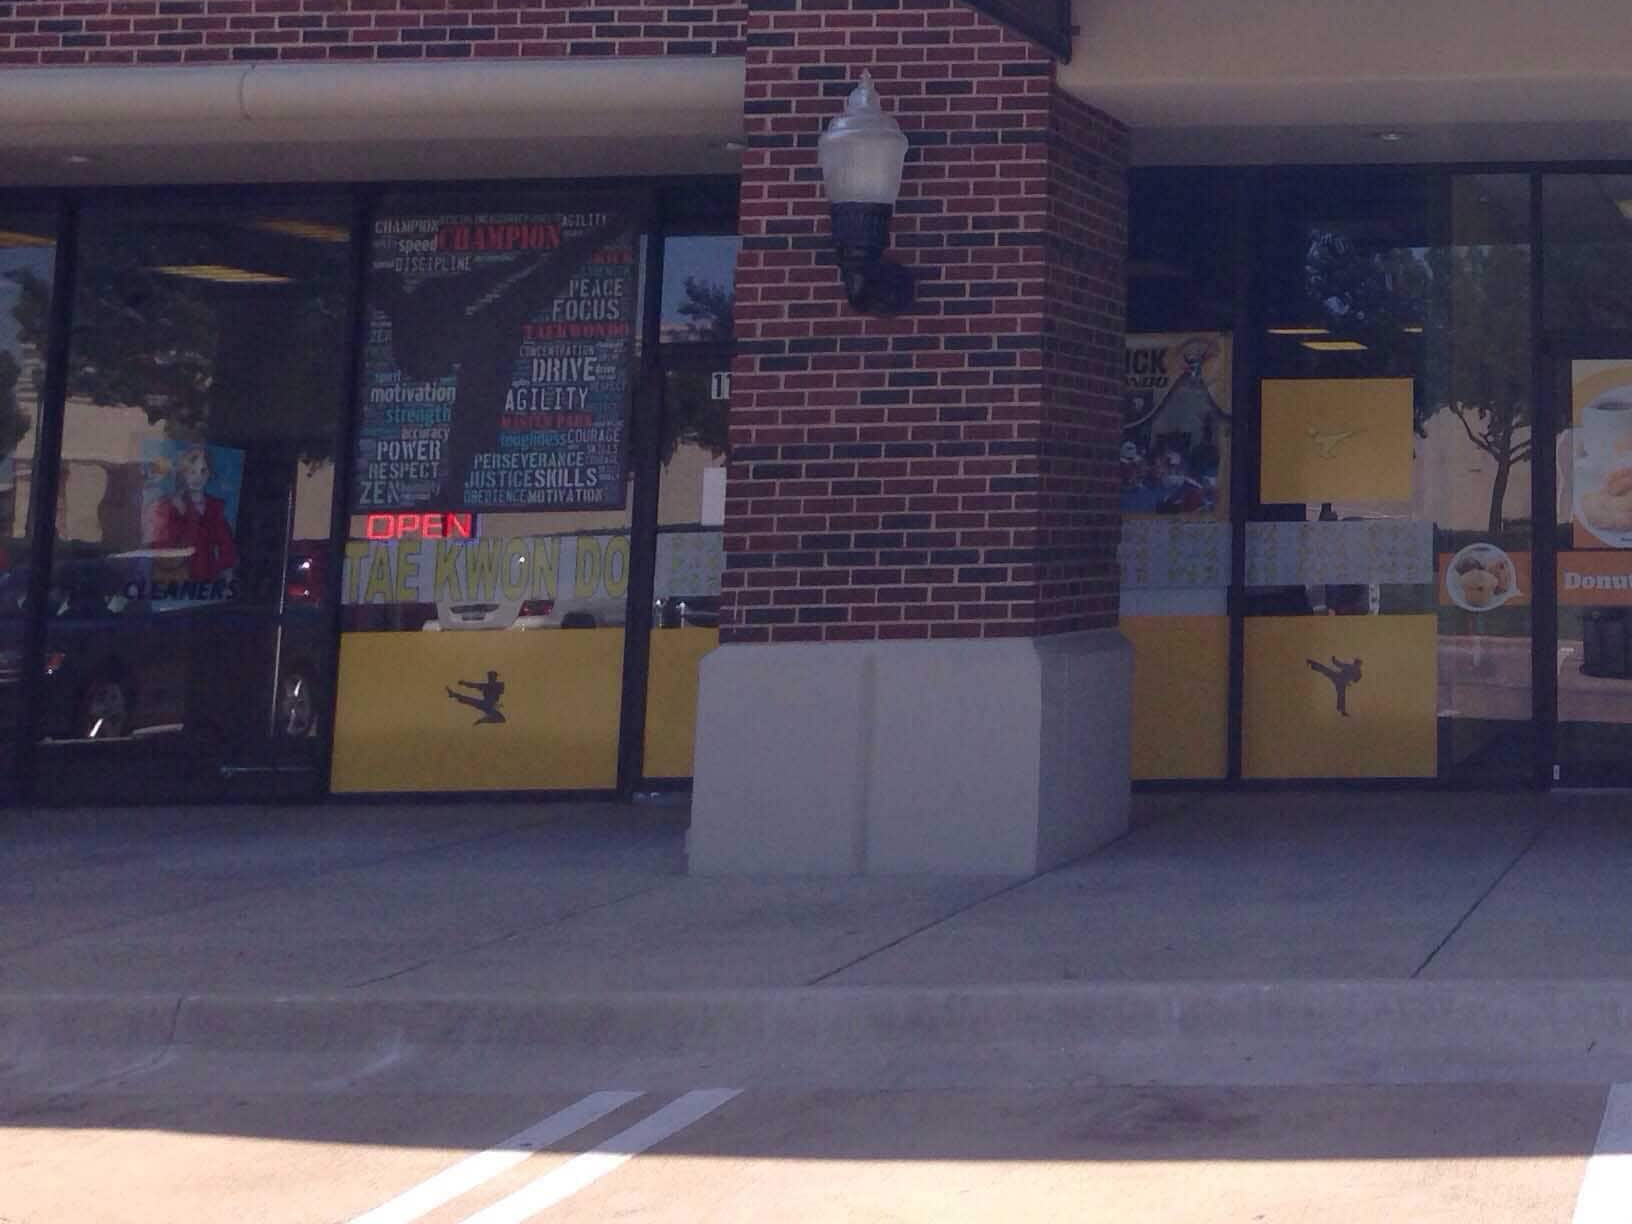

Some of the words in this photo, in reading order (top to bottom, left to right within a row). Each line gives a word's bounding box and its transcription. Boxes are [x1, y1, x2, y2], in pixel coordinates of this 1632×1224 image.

[399, 236, 438, 254] speed
[439, 223, 561, 251] CHAMPION
[395, 255, 472, 273] DISCIPLINE
[569, 279, 624, 297] PEACE
[552, 298, 620, 321] FOCUS
[532, 356, 597, 382] DRIVE
[1123, 349, 1168, 374] ICK
[370, 381, 456, 403] motivation
[505, 386, 588, 412] AGILITY
[384, 404, 450, 428] strength
[401, 427, 450, 441] accuracy
[567, 428, 621, 443] COURAGE
[376, 440, 441, 461] POWER
[474, 451, 584, 469] PERSEVERANCE
[368, 462, 440, 479] RESPECT
[464, 469, 533, 488] JUSTICE
[534, 467, 598, 488] SKILLS
[359, 481, 399, 504] ZEN
[528, 487, 603, 503] MOTIVATION
[366, 514, 472, 539] OPEN
[342, 539, 421, 602] TAE
[433, 536, 560, 601] KWON
[575, 534, 630, 600] DO
[124, 579, 240, 601] CLEANERS
